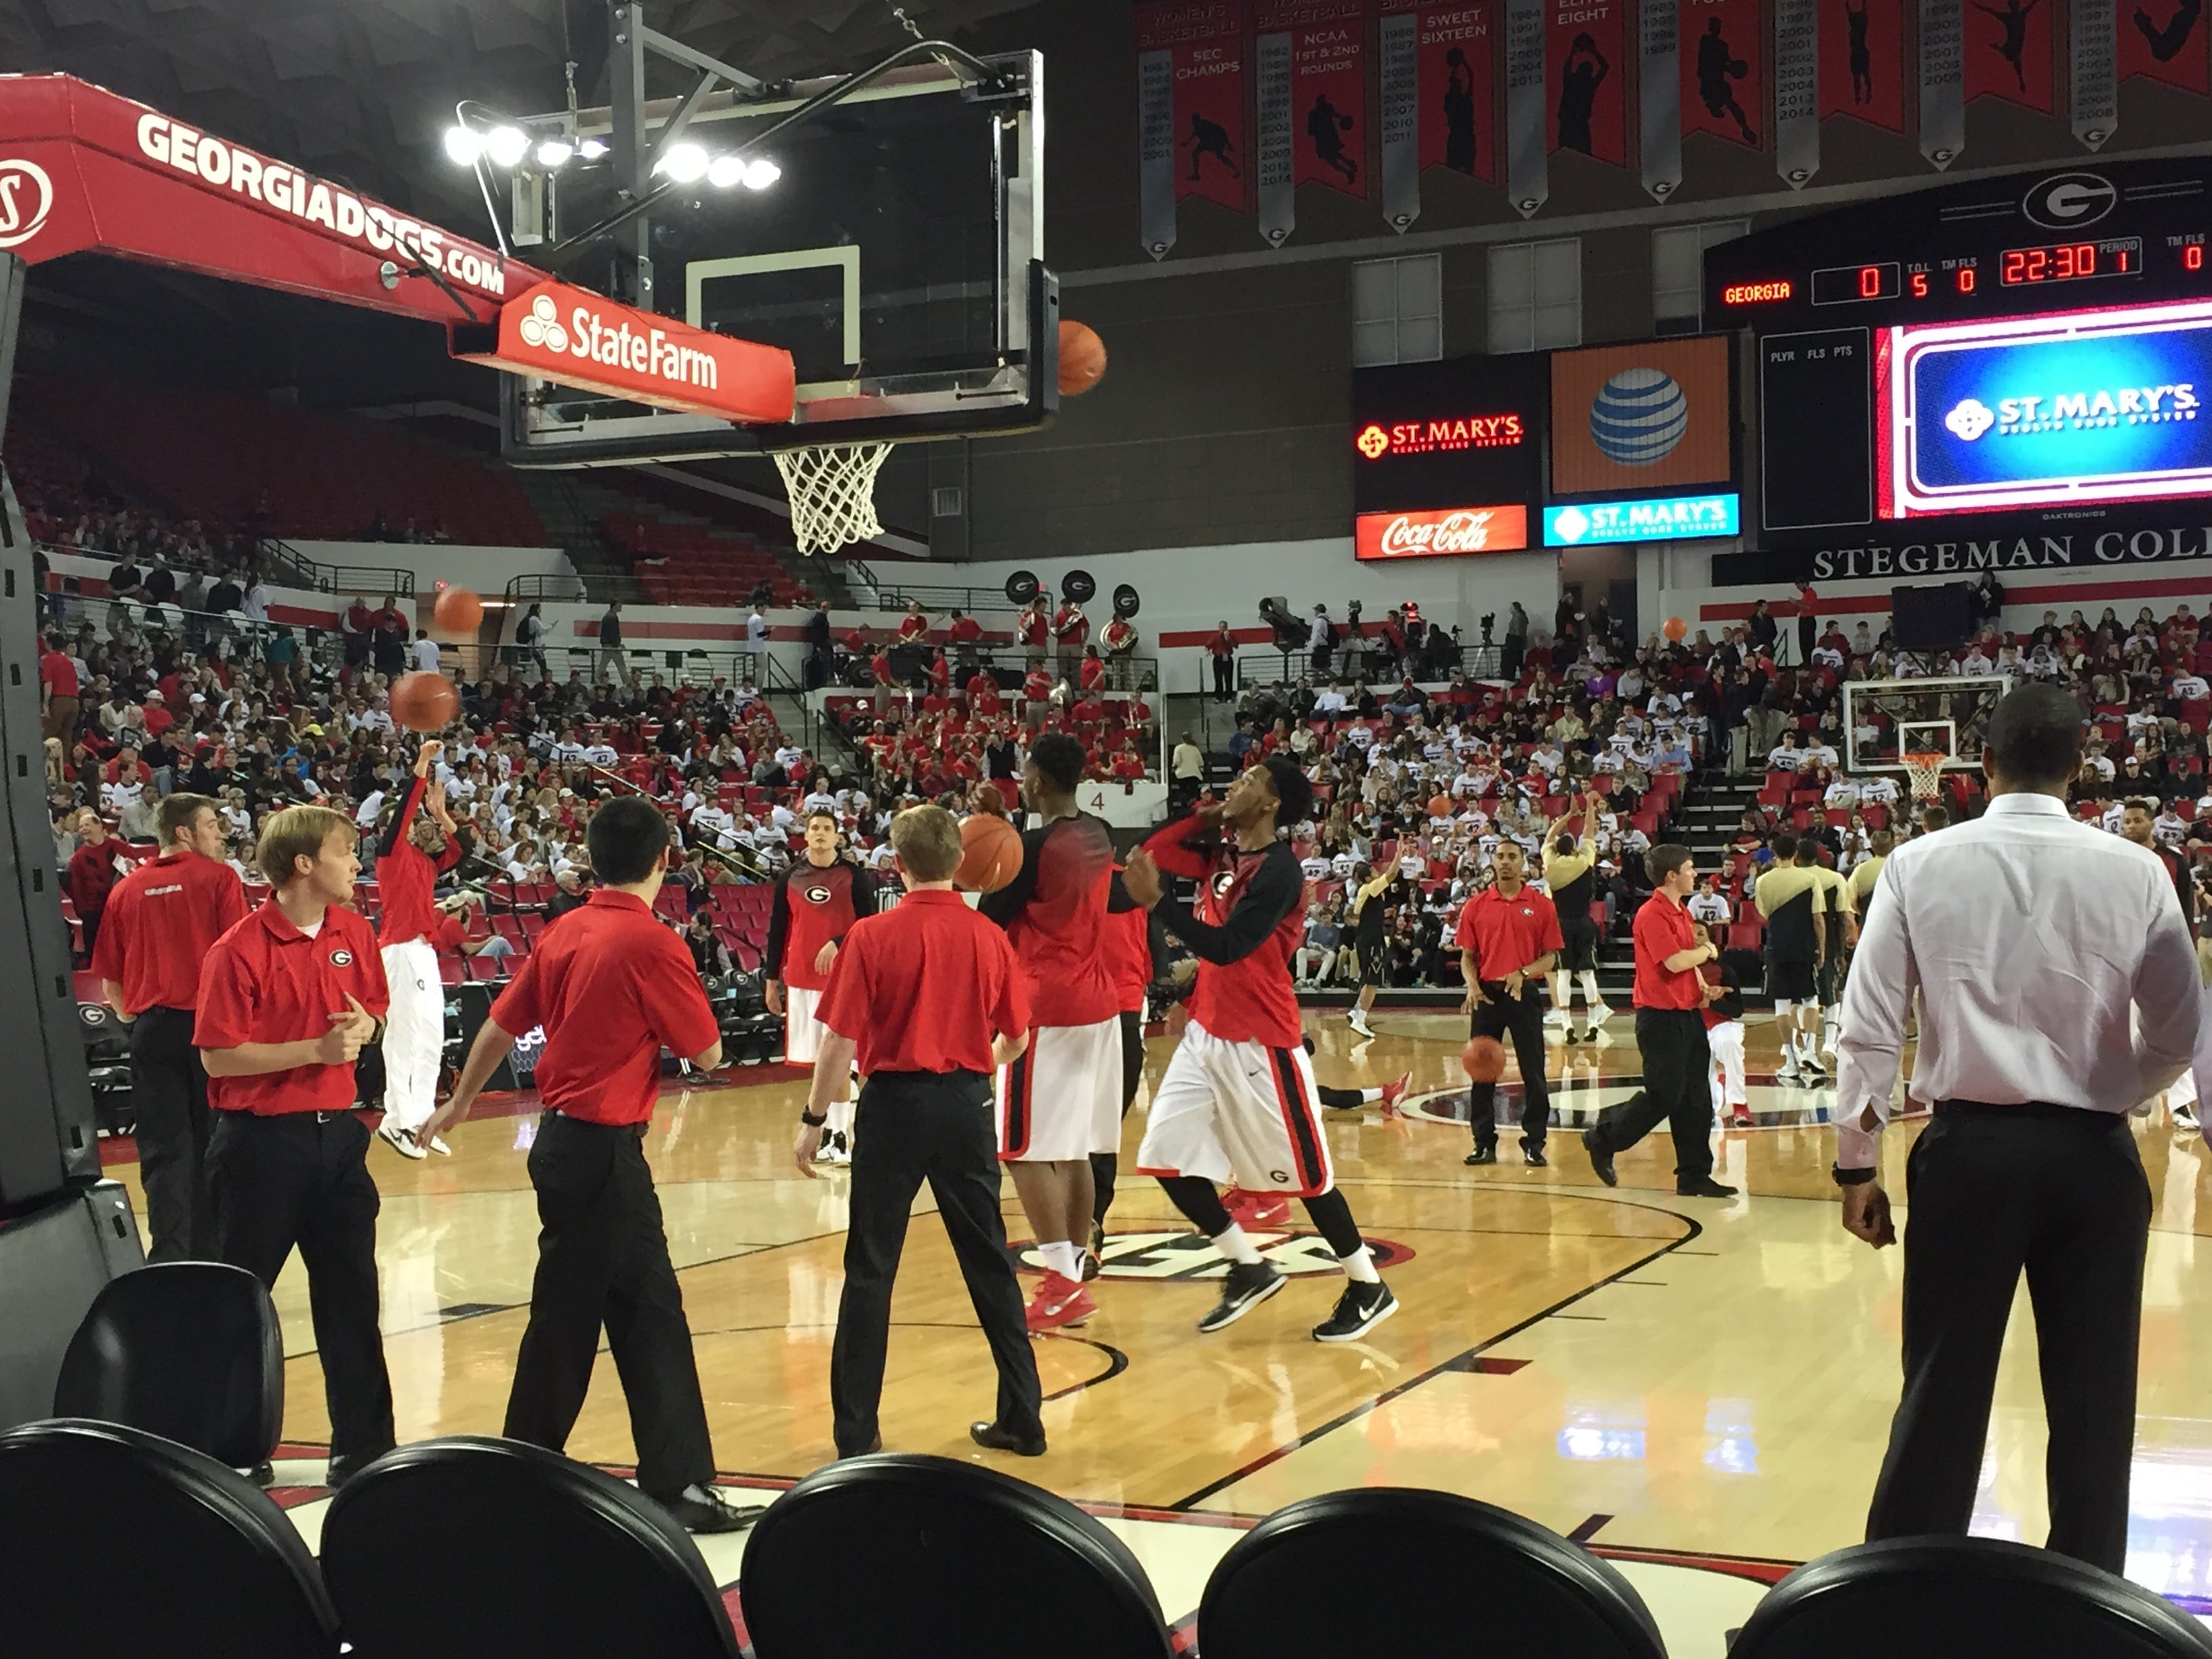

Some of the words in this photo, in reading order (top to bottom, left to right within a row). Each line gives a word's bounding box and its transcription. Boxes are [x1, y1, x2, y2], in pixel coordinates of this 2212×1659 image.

[1427, 9, 1481, 27] SWEET
[1557, 7, 1610, 25] EIGHT
[1421, 24, 1487, 44] SIXTEEN
[1512, 22, 1538, 34] 1991
[1779, 25, 1814, 38] 2000
[1305, 30, 1348, 45] NCAA
[1780, 39, 1811, 52] 2001
[1193, 48, 1222, 61] SEC
[1296, 50, 1317, 61] 1ST
[1319, 47, 1330, 58] &
[1332, 45, 1359, 56] 2ND
[1510, 48, 1542, 60] 2000
[1779, 53, 1814, 65] 2002
[1925, 46, 1960, 60] 2007
[1176, 62, 1240, 79] CHAMPS
[1300, 60, 1353, 75] ROUNDS
[1510, 61, 1542, 73] 2004
[1779, 66, 1814, 79] 2003
[1510, 75, 1542, 87] 2013
[1779, 79, 1814, 92] 2004
[1384, 105, 1414, 116] 2007
[1780, 106, 1814, 121] 2014
[2078, 107, 2113, 119] 2008
[1384, 118, 1413, 129] 2010
[1385, 131, 1412, 143] 2011
[2084, 129, 2106, 142] G
[1931, 149, 1952, 161] G
[1261, 174, 1291, 185] 2014
[1789, 169, 1809, 181] G
[1653, 182, 1672, 194] G
[138, 113, 504, 295] GEORGIADOGS.COM
[1519, 199, 1538, 210] G
[2034, 178, 2116, 224] G
[1393, 214, 1410, 226] G
[1269, 228, 1286, 240] G
[2166, 237, 2183, 247] TM
[2186, 233, 2205, 245] FLS
[1151, 242, 1168, 253] G
[2100, 240, 2138, 253] PERIOD
[1941, 259, 1957, 270] TM
[1959, 257, 1978, 268] FLS
[2006, 245, 2095, 283] 22:30
[2119, 251, 2127, 272] 1
[2186, 246, 2203, 269] 0
[1862, 267, 1880, 298] 0
[1912, 273, 1928, 297] 5
[1959, 269, 1975, 292] 0
[1725, 282, 1790, 304] GEORGIA
[1770, 351, 1795, 362] PLYR
[1807, 348, 1826, 359] FLS
[1833, 346, 1853, 356] PTS
[1999, 396, 2049, 424] ST.
[2054, 384, 2198, 419] MARY'S
[1393, 424, 1425, 445] ST.
[1428, 415, 1519, 442] MARY'S
[1592, 507, 1626, 529] ST.
[1629, 500, 1727, 527] MARY'S
[1381, 512, 1494, 555] Coca-Cola
[1813, 535, 2075, 579] STEGEMAN
[1090, 792, 1105, 810] 4
[808, 887, 831, 902] G
[1702, 910, 1717, 921] 42
[332, 951, 352, 966] G
[82, 1008, 104, 1023] G
[1269, 1170, 1289, 1183] G
